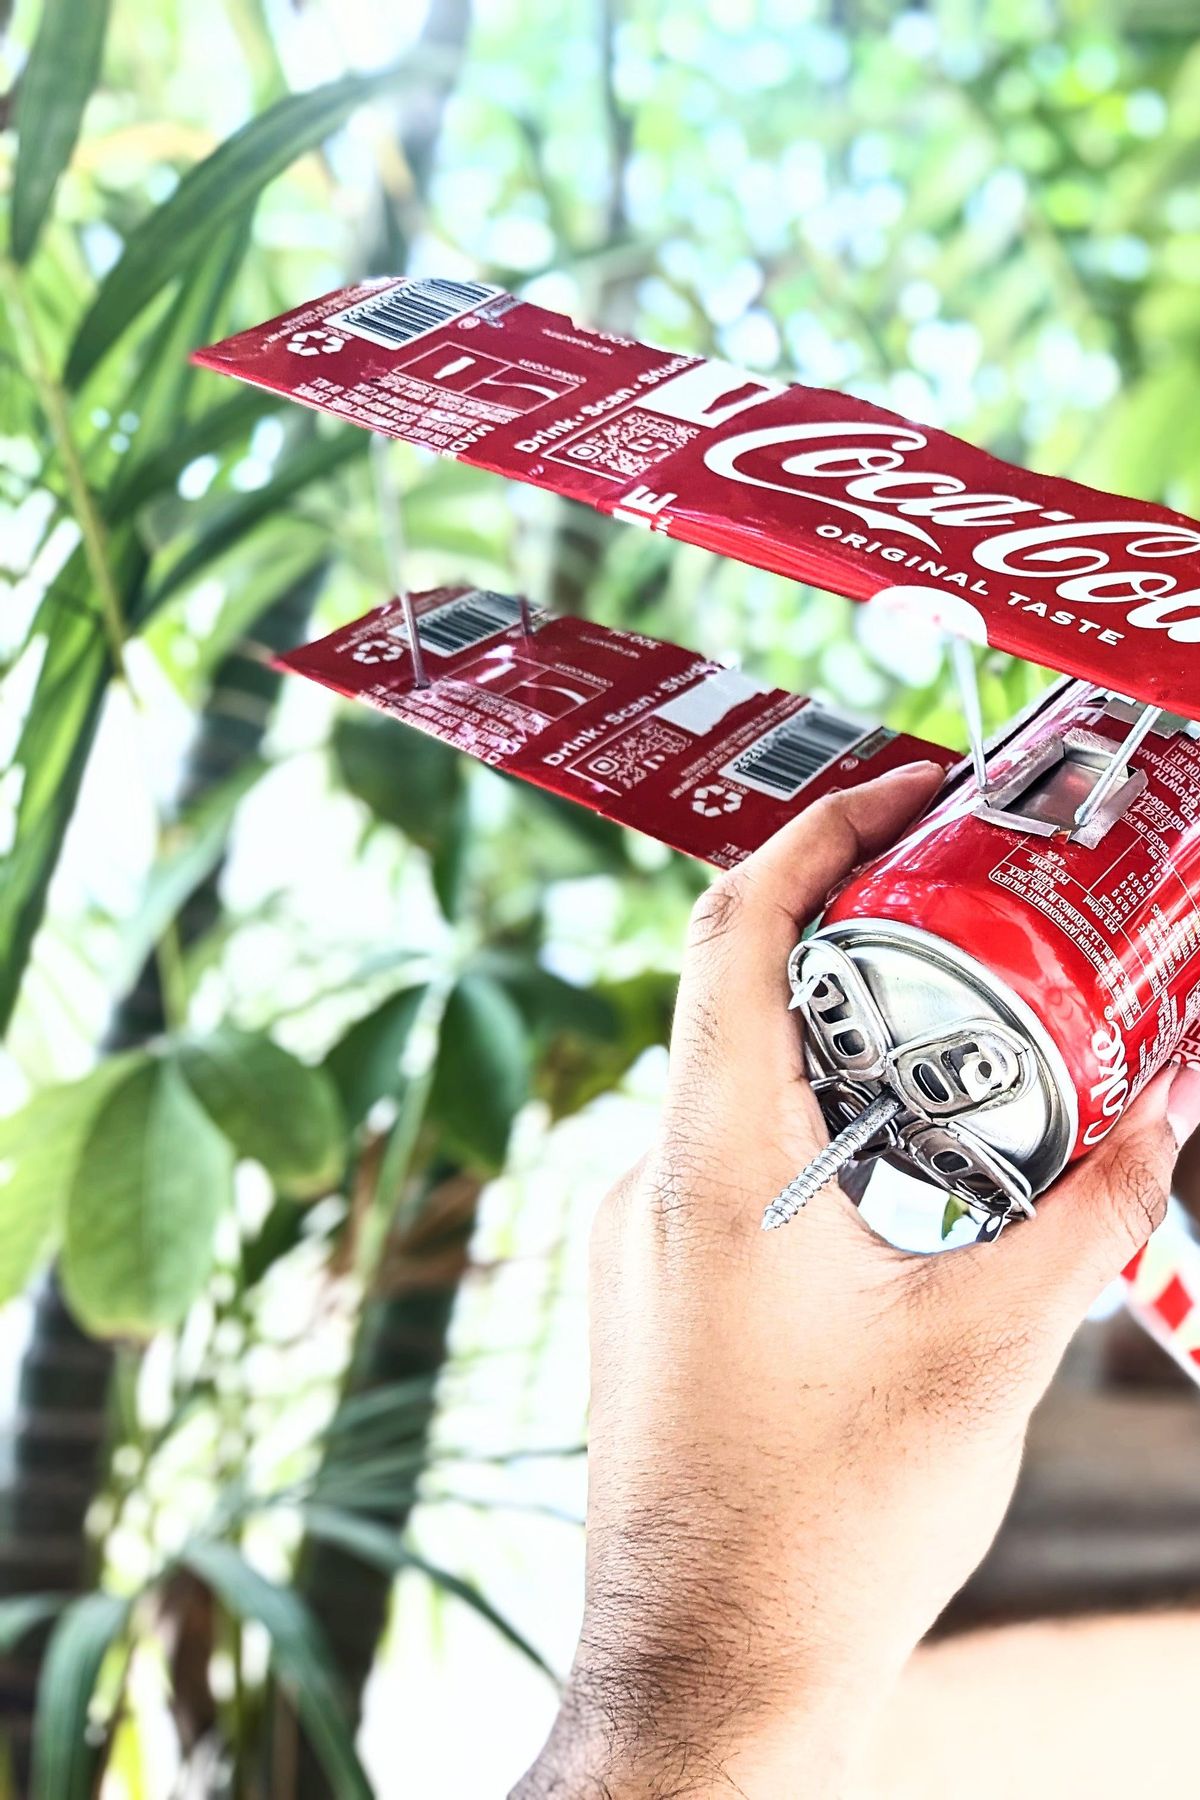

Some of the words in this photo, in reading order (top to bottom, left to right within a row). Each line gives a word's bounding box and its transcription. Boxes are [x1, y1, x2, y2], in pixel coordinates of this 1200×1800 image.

[514, 417, 577, 453] Drink
[580, 387, 636, 417] Scan
[815, 524, 991, 596] ORIGINAL
[1007, 592, 1126, 647] TASTE
[541, 731, 600, 768] Drink
[605, 694, 656, 726] Scan
[1169, 749, 1187, 765] AT:
[1152, 767, 1199, 810] GROWTH
[1134, 820, 1148, 833] ON
[1043, 847, 1067, 868] 4.4%
[1146, 844, 1160, 859] mg
[1025, 850, 1055, 875] SERVE
[994, 866, 1029, 892] VALUES)
[1005, 863, 1032, 884] PACK
[1049, 867, 1071, 886] PER
[1025, 876, 1049, 898] THIS
[1043, 890, 1059, 904] IN
[1122, 885, 1141, 905] 10.6
[1130, 877, 1149, 897] 10.6
[1023, 885, 1080, 938] (APPROXIMATE
[1081, 893, 1107, 920] 100ml
[1096, 893, 1116, 912] kcal
[1113, 894, 1132, 913] 10.9
[1053, 897, 1093, 936] SERVINGS
[1102, 915, 1119, 934] PER
[1086, 930, 1103, 948] 1.5
[1097, 945, 1113, 961] ml
[1083, 1020, 1129, 1145] Coke
